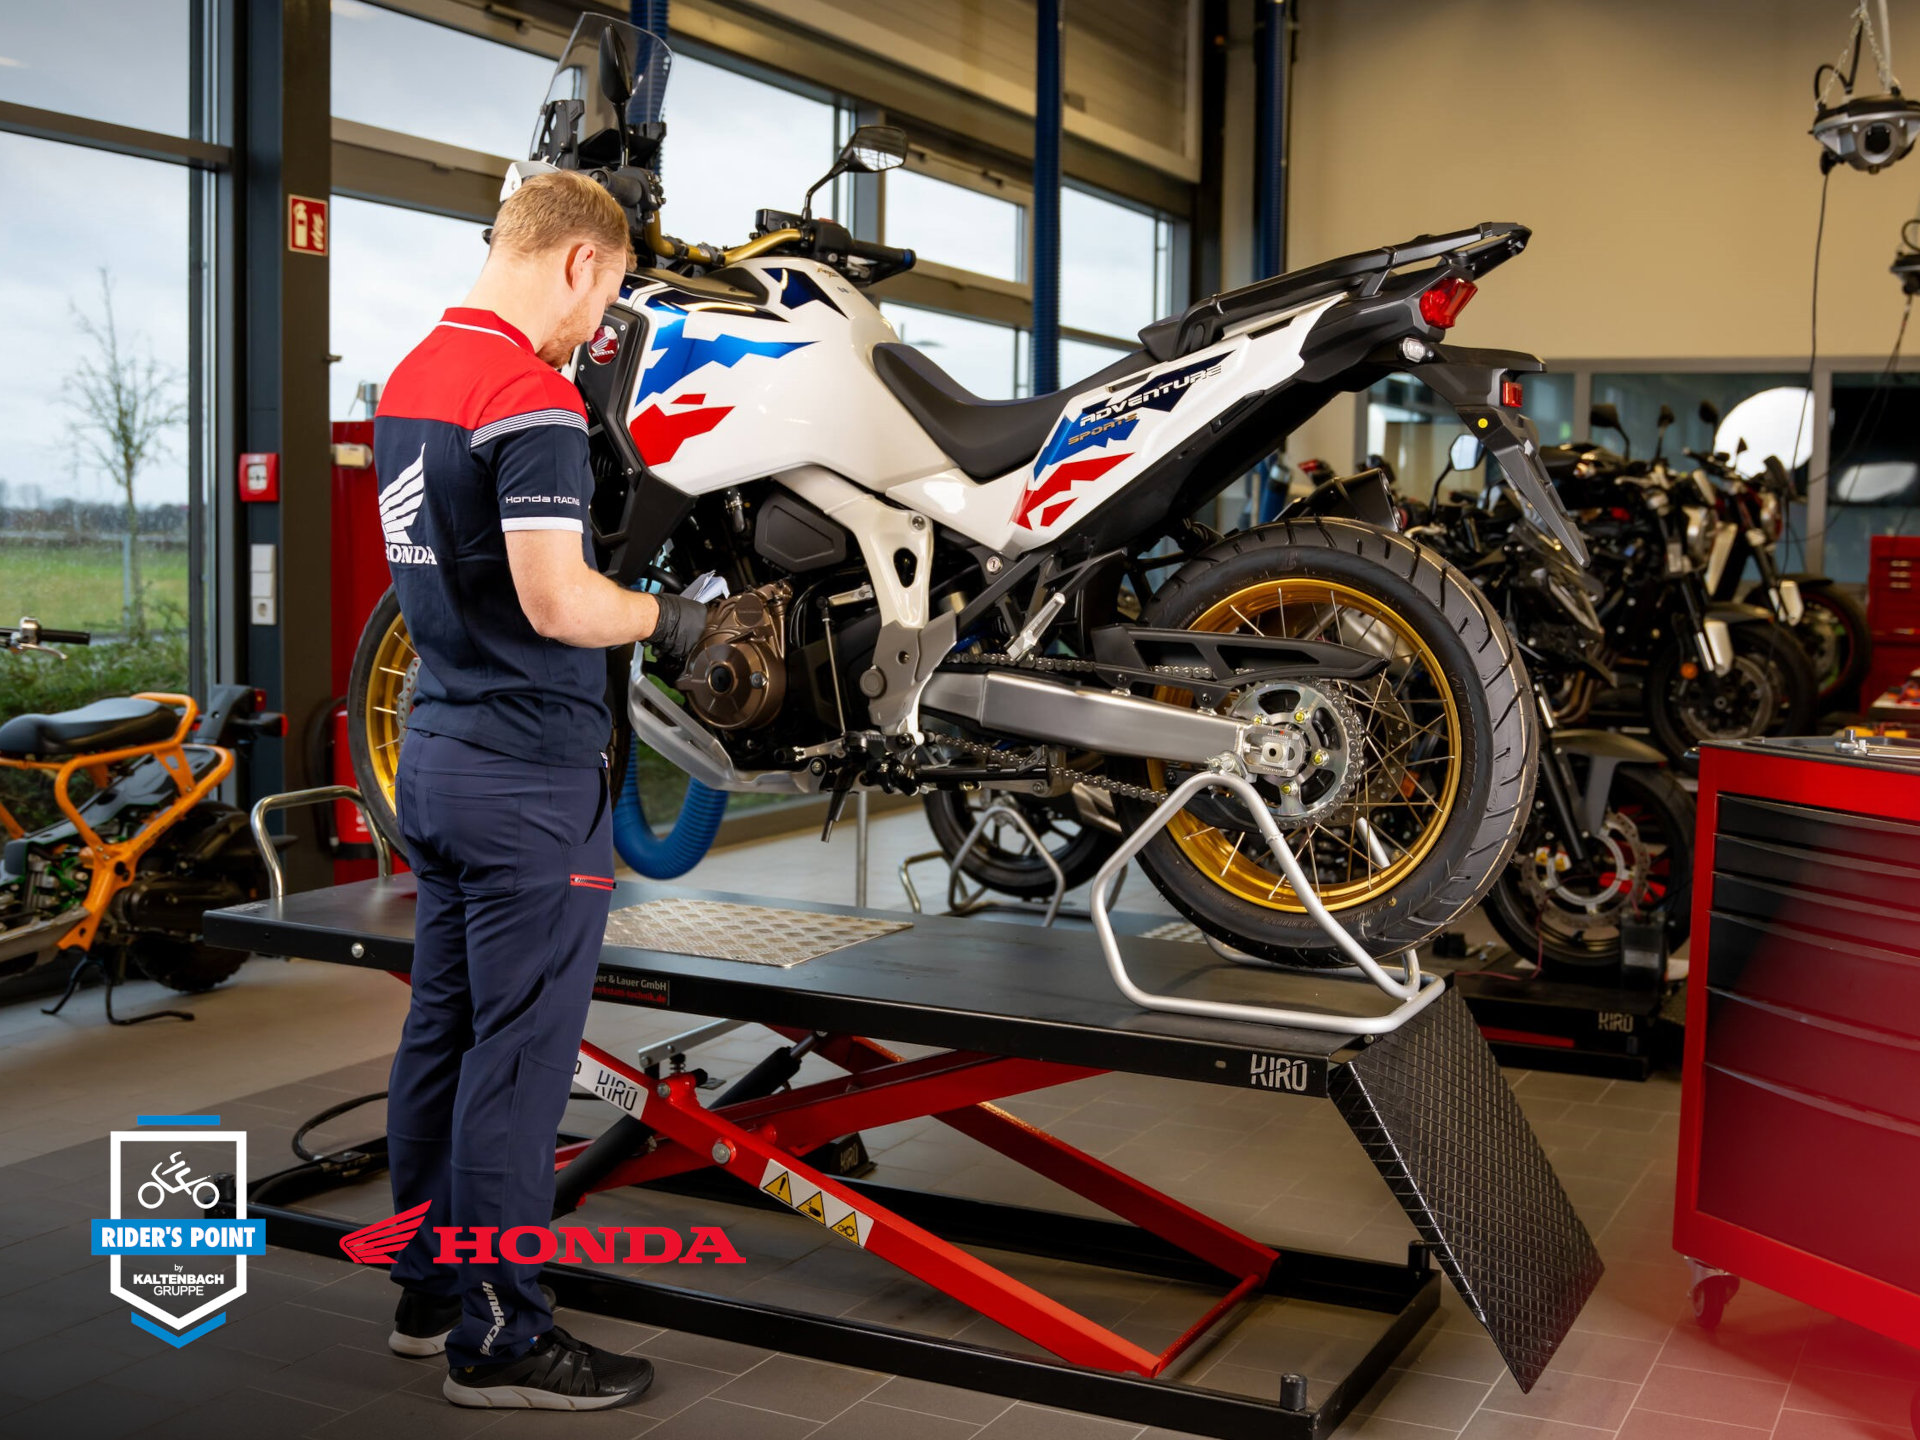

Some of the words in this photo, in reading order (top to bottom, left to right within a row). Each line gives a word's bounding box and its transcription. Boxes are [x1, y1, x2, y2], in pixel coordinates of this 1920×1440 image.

[1080, 365, 1222, 427] ADVENTURE
[1068, 412, 1138, 446] SPORTS
[505, 494, 551, 504] Honda
[616, 976, 640, 988] Lauer
[640, 979, 667, 992] GmbH
[1597, 1010, 1634, 1033] KIRO
[1250, 1053, 1308, 1092] KIRO
[594, 1069, 639, 1112] KIRO
